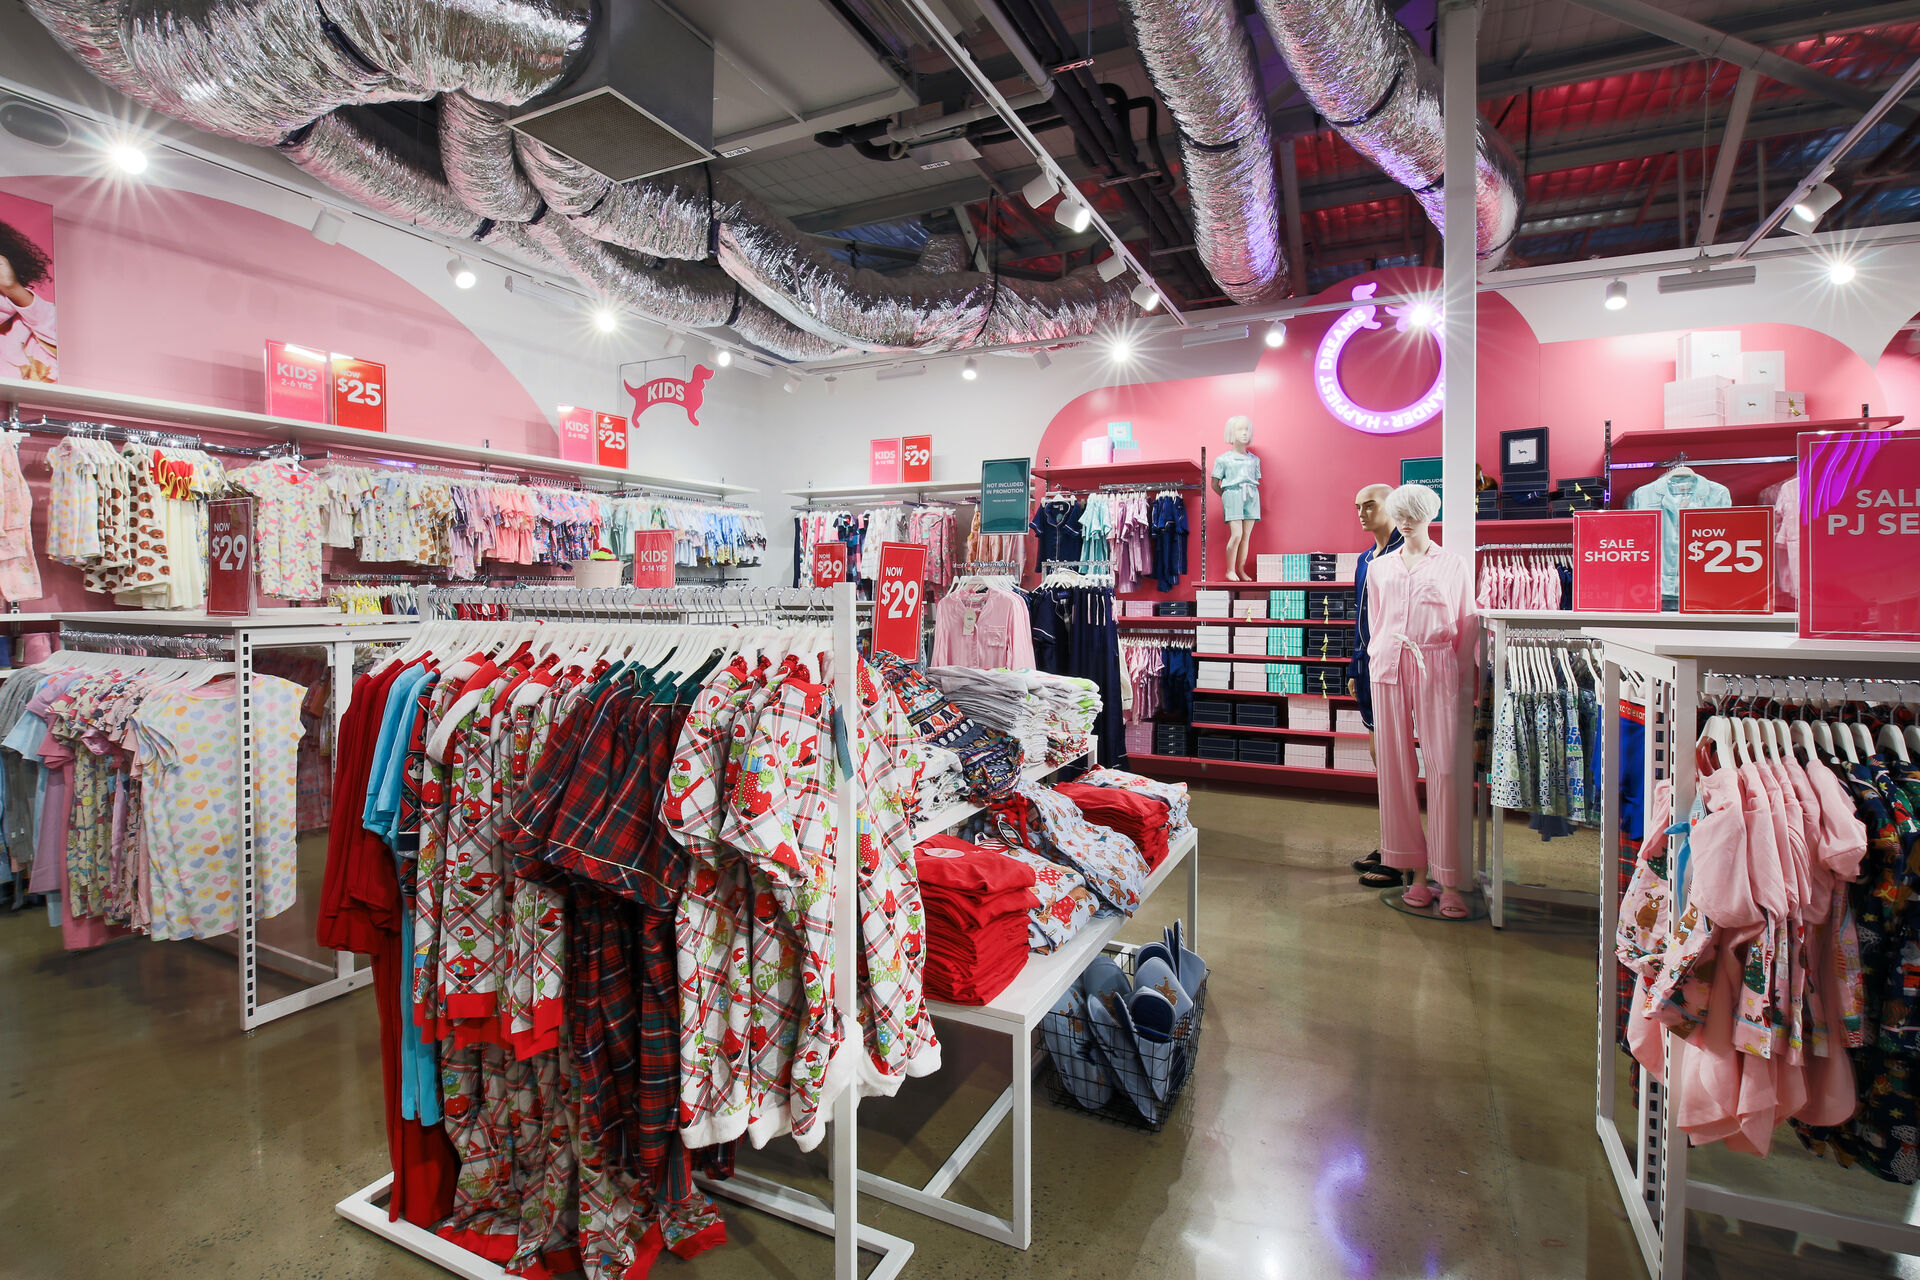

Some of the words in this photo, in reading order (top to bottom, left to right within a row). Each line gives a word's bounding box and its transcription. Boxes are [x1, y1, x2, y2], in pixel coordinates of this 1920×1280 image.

[1319, 309, 1366, 370] DREAMS
[276, 362, 317, 382] KIDS
[280, 378, 296, 387] 2-6
[297, 381, 313, 390] YRS
[337, 377, 381, 407] $25
[647, 382, 685, 402] KIDS
[1319, 376, 1381, 429] HAPPIEST
[565, 420, 590, 433] KIDS
[599, 429, 626, 450] $25
[874, 450, 896, 460] KIDS
[904, 449, 930, 466] $29
[213, 522, 231, 532] NOW
[1691, 528, 1726, 538] NOW
[1827, 514, 1865, 535] PJ
[1877, 513, 1920, 535] SE
[211, 534, 248, 571] $29
[1599, 539, 1635, 549] SALE
[641, 550, 668, 563] KIDS
[1584, 550, 1650, 562] SHORTS
[1687, 539, 1763, 574] $25
[817, 559, 843, 579] $29
[885, 566, 904, 577] NOW
[881, 580, 919, 619] $29
[756, 966, 797, 990] GRINC
